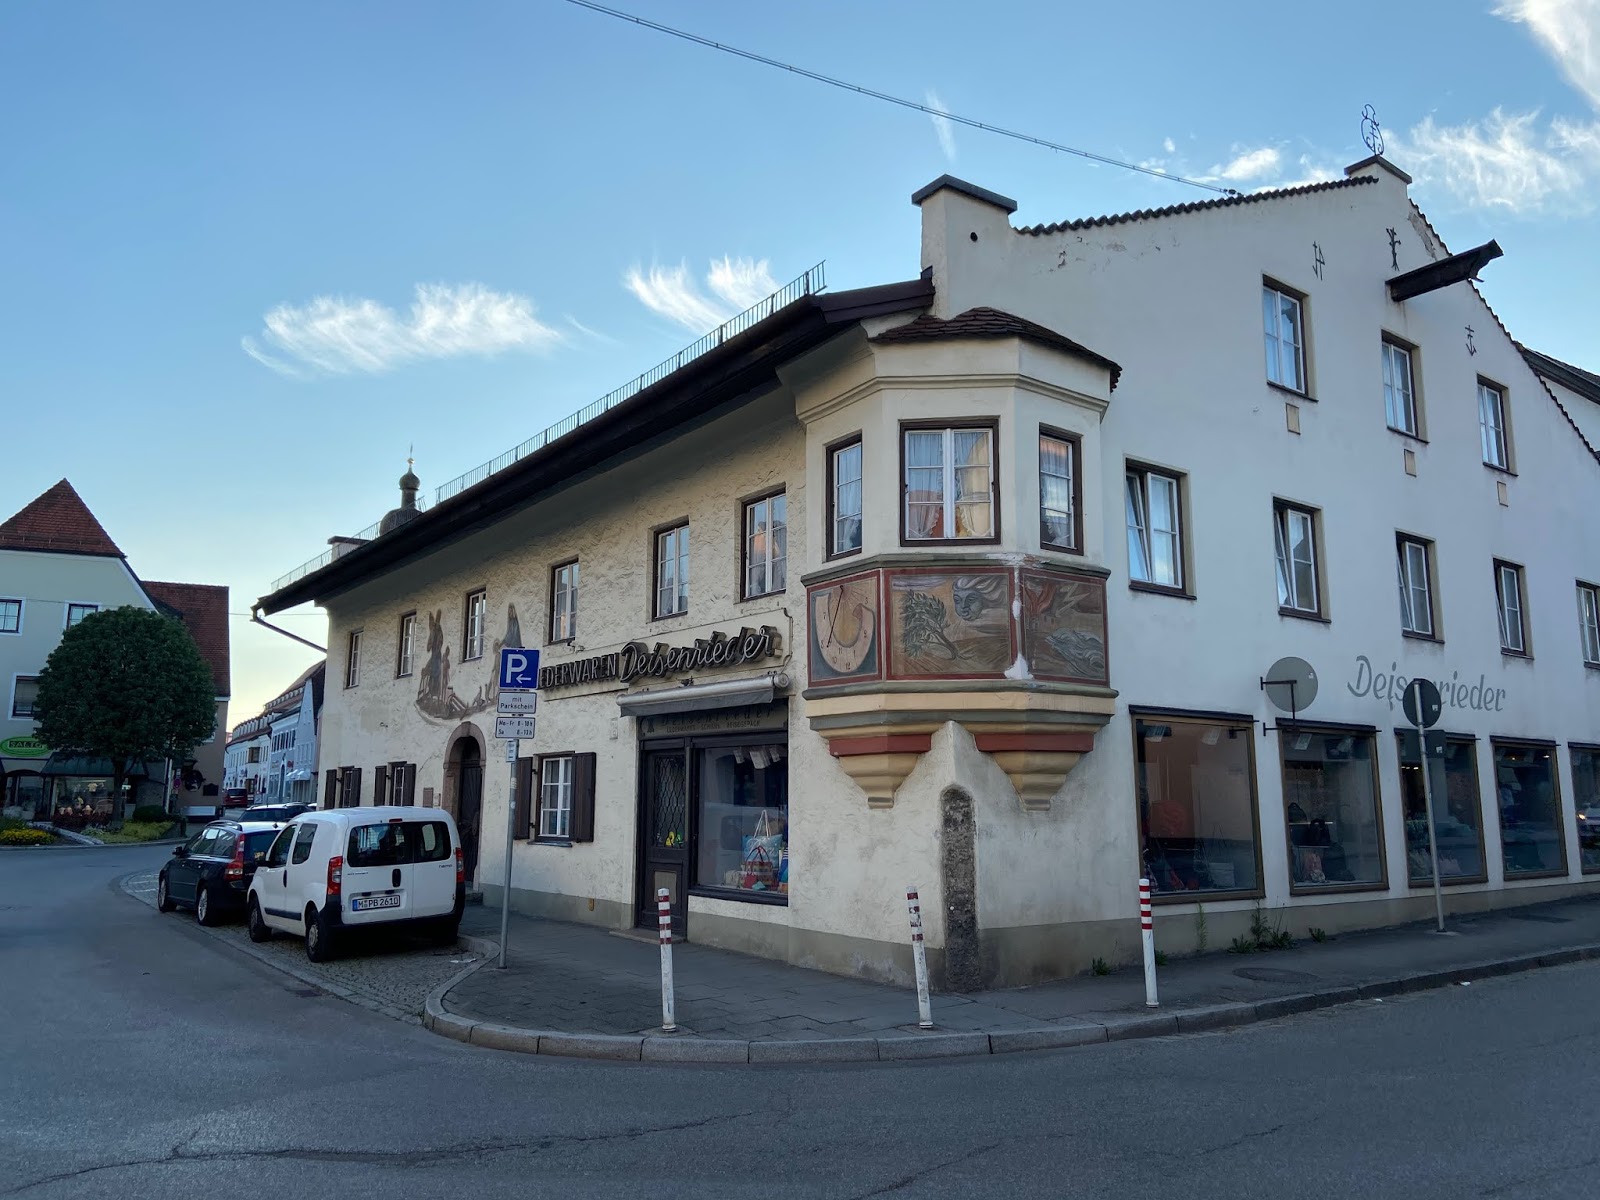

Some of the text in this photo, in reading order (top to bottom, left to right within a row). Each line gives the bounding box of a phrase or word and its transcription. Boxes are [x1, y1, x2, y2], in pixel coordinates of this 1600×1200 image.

[538, 626, 778, 689] EDERWAREN Deisenrieder
[505, 653, 528, 684] P
[1346, 655, 1506, 712] Deisrieder
[500, 702, 534, 711] Parkschein
[10, 740, 41, 748] SALTO
[358, 896, 399, 908] M PB 2610
